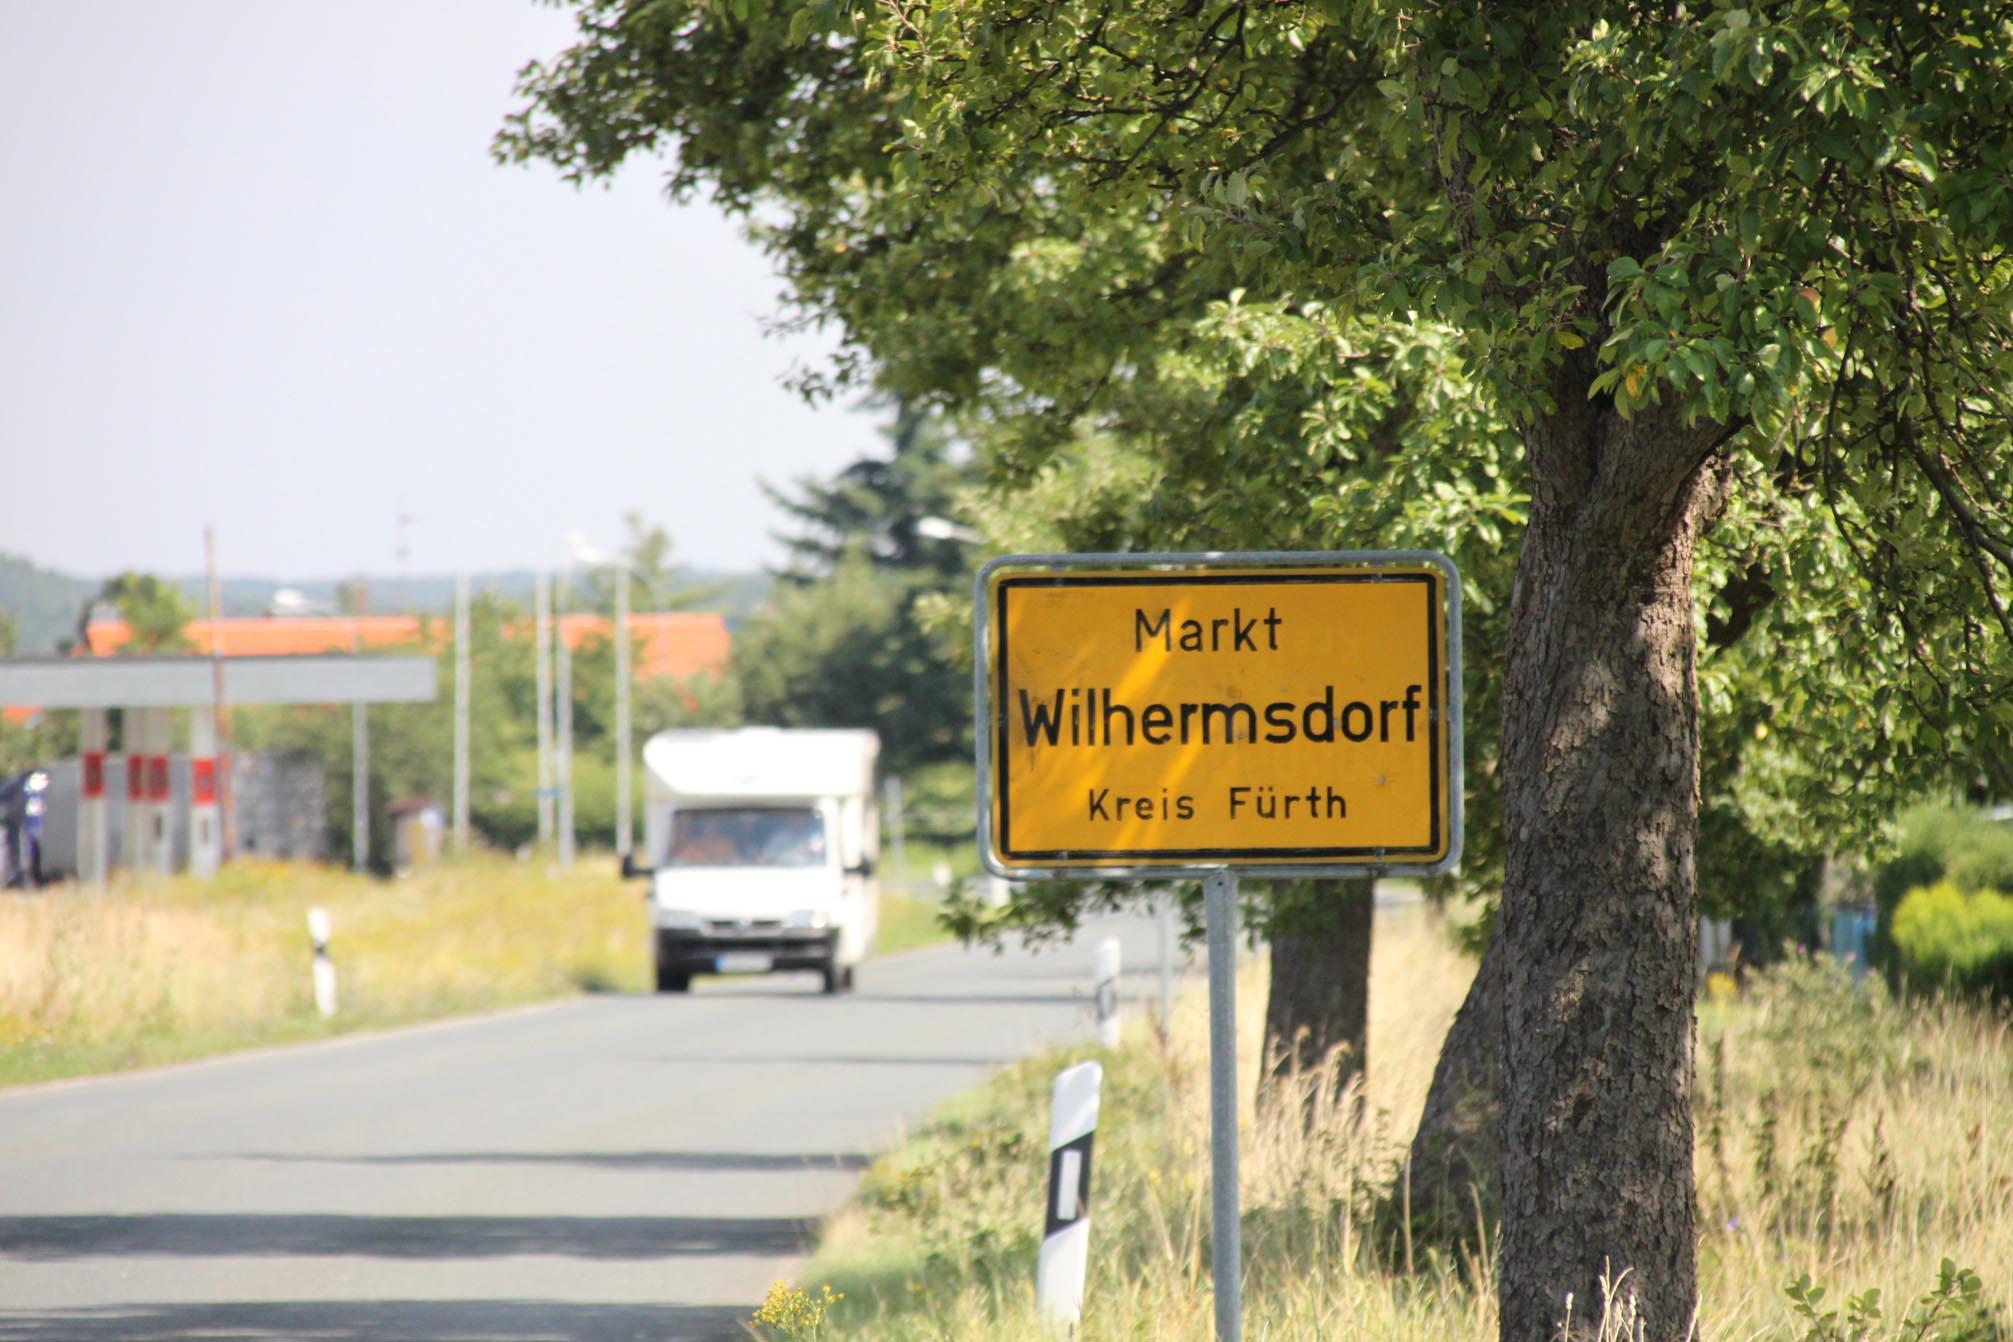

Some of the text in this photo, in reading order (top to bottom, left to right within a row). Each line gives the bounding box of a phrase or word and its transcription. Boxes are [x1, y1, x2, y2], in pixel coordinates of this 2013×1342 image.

[1135, 607, 1284, 652] Markt
[1017, 684, 1424, 748] Wilhermsdorf
[1088, 785, 1348, 821] Kreis Fürth
